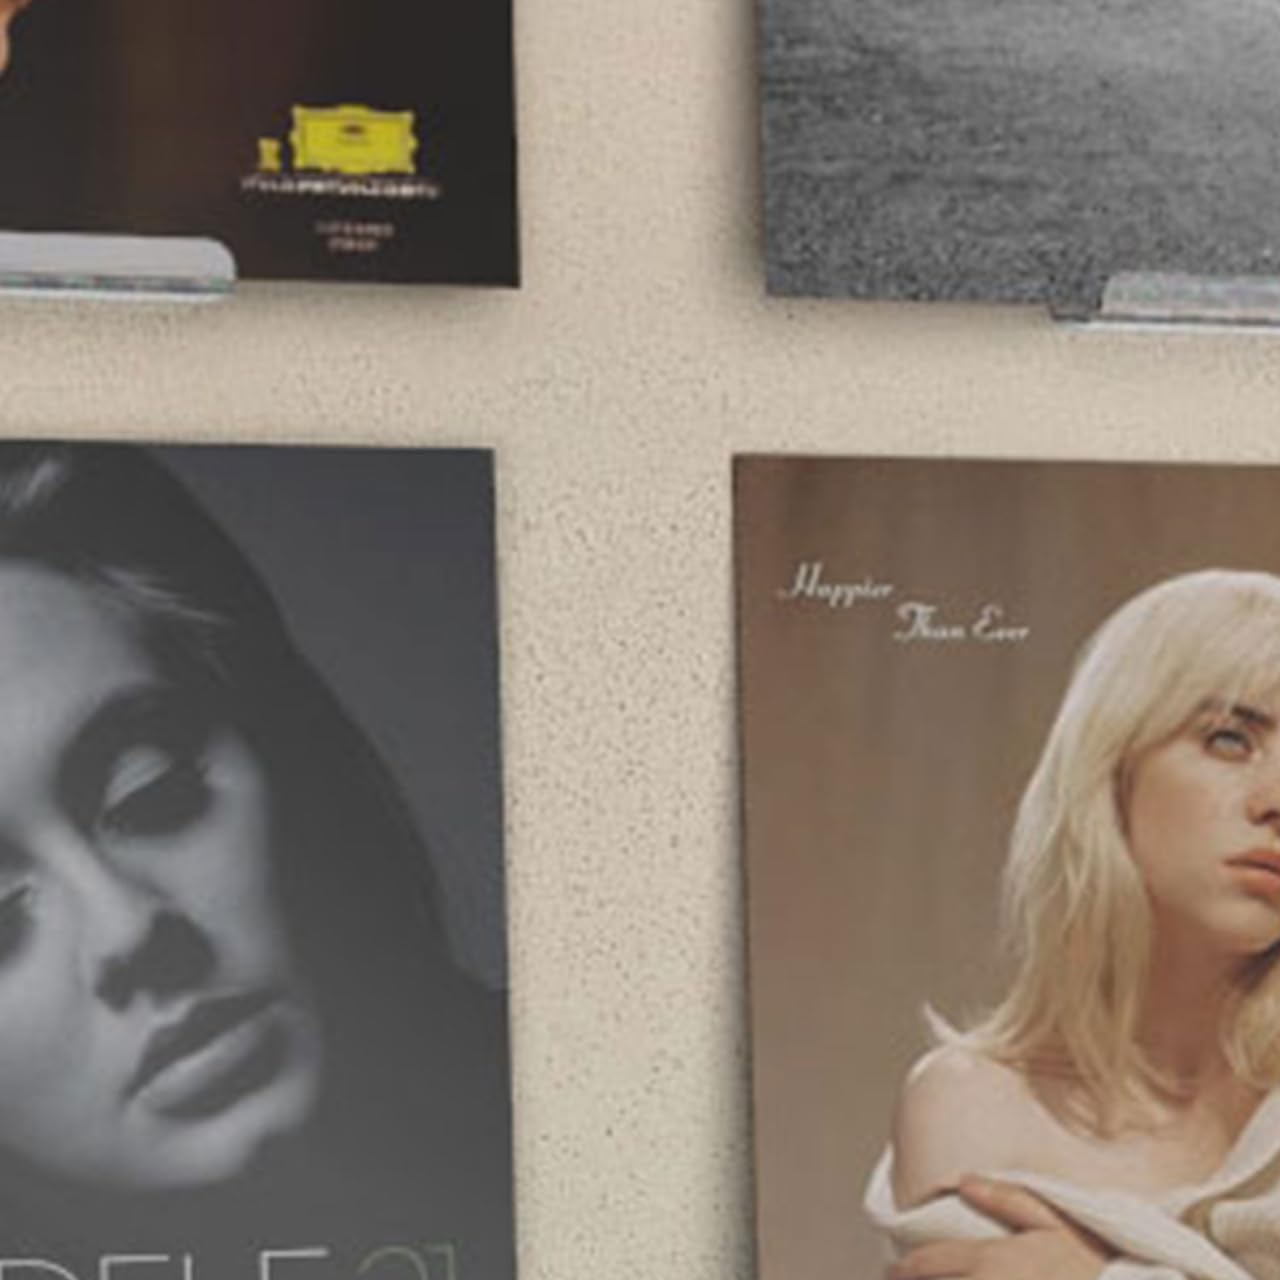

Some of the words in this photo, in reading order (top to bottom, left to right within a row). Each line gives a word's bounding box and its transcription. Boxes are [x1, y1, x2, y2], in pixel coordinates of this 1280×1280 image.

[775, 561, 894, 608] Happier
[892, 602, 967, 643] Than
[971, 603, 1030, 641] Ever
